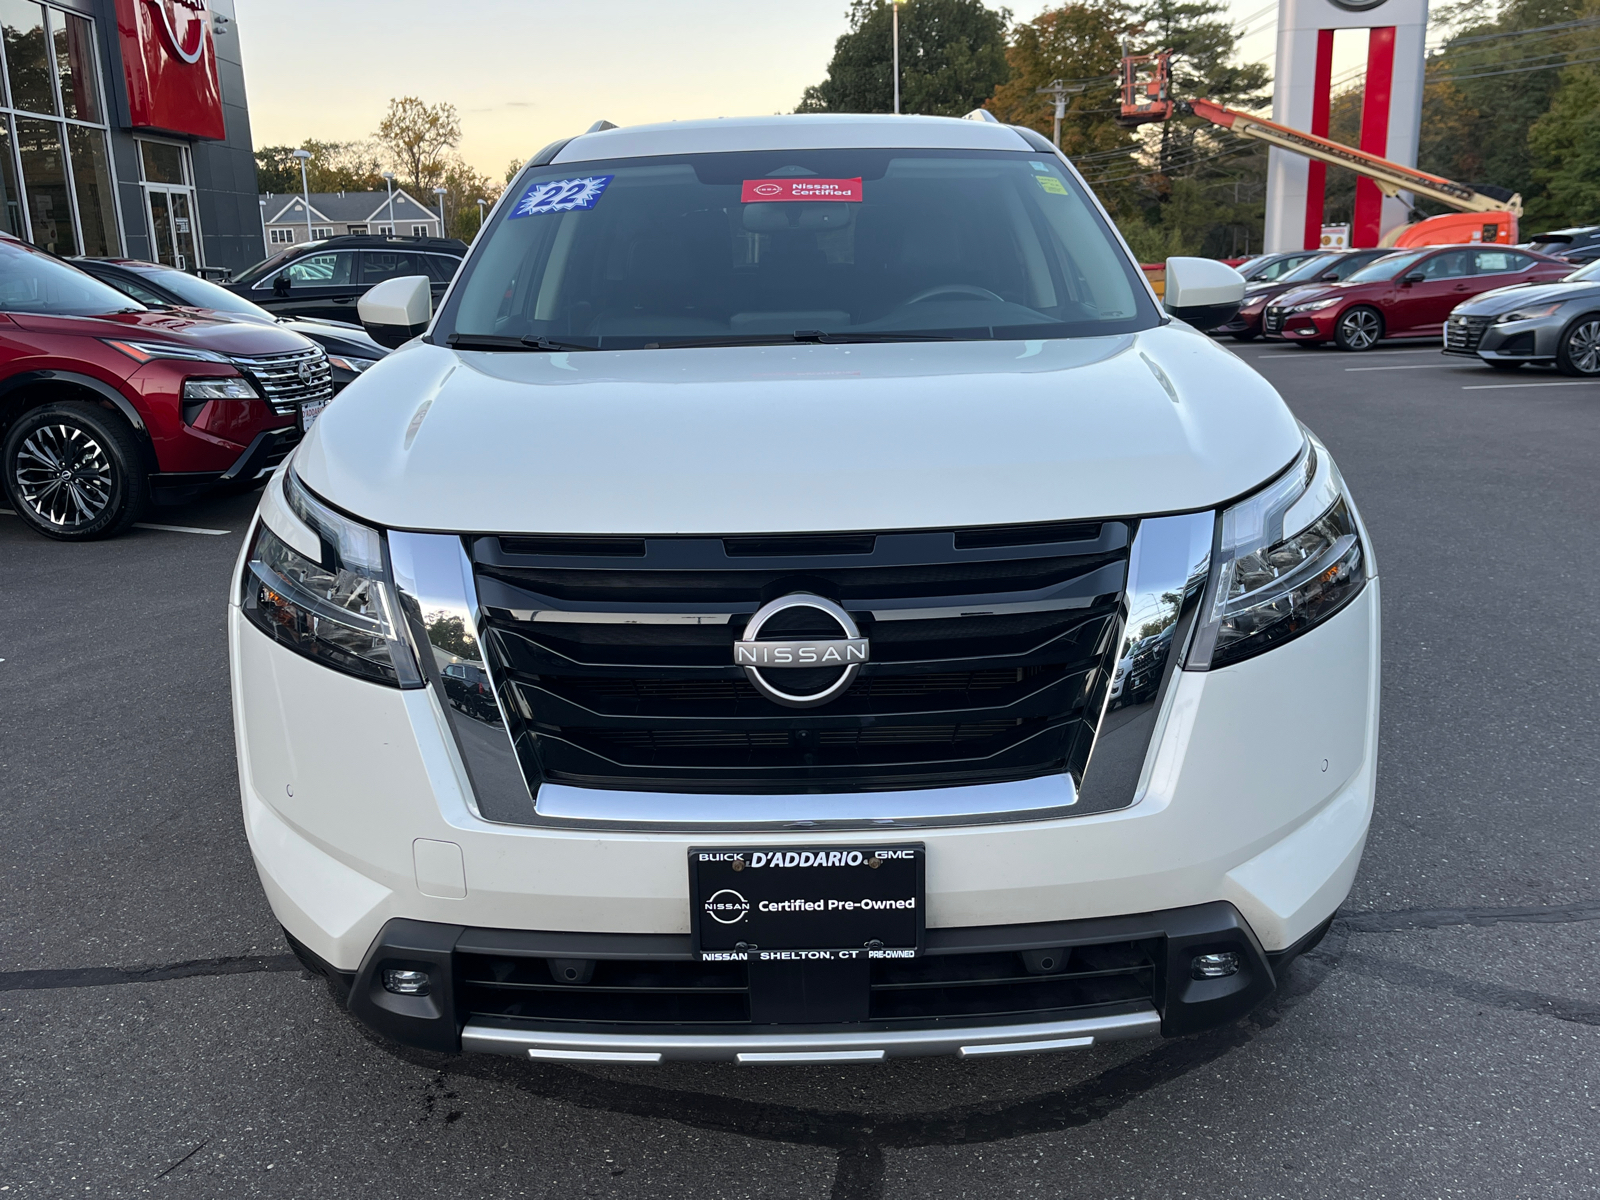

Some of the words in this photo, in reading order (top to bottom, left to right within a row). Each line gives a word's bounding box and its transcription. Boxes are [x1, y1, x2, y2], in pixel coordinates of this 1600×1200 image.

[532, 182, 588, 208] 22
[738, 643, 866, 663] NISSAN
[699, 853, 744, 862] BUICK
[751, 850, 863, 868] D'ADDARIO
[875, 850, 914, 859] GMC
[758, 899, 825, 912] Certified
[828, 897, 916, 911] Pre-Owned
[702, 952, 748, 961] NISSAN
[760, 951, 835, 960] SHELTON,
[838, 950, 860, 959] CT
[868, 950, 915, 959] PRE-OWNED
